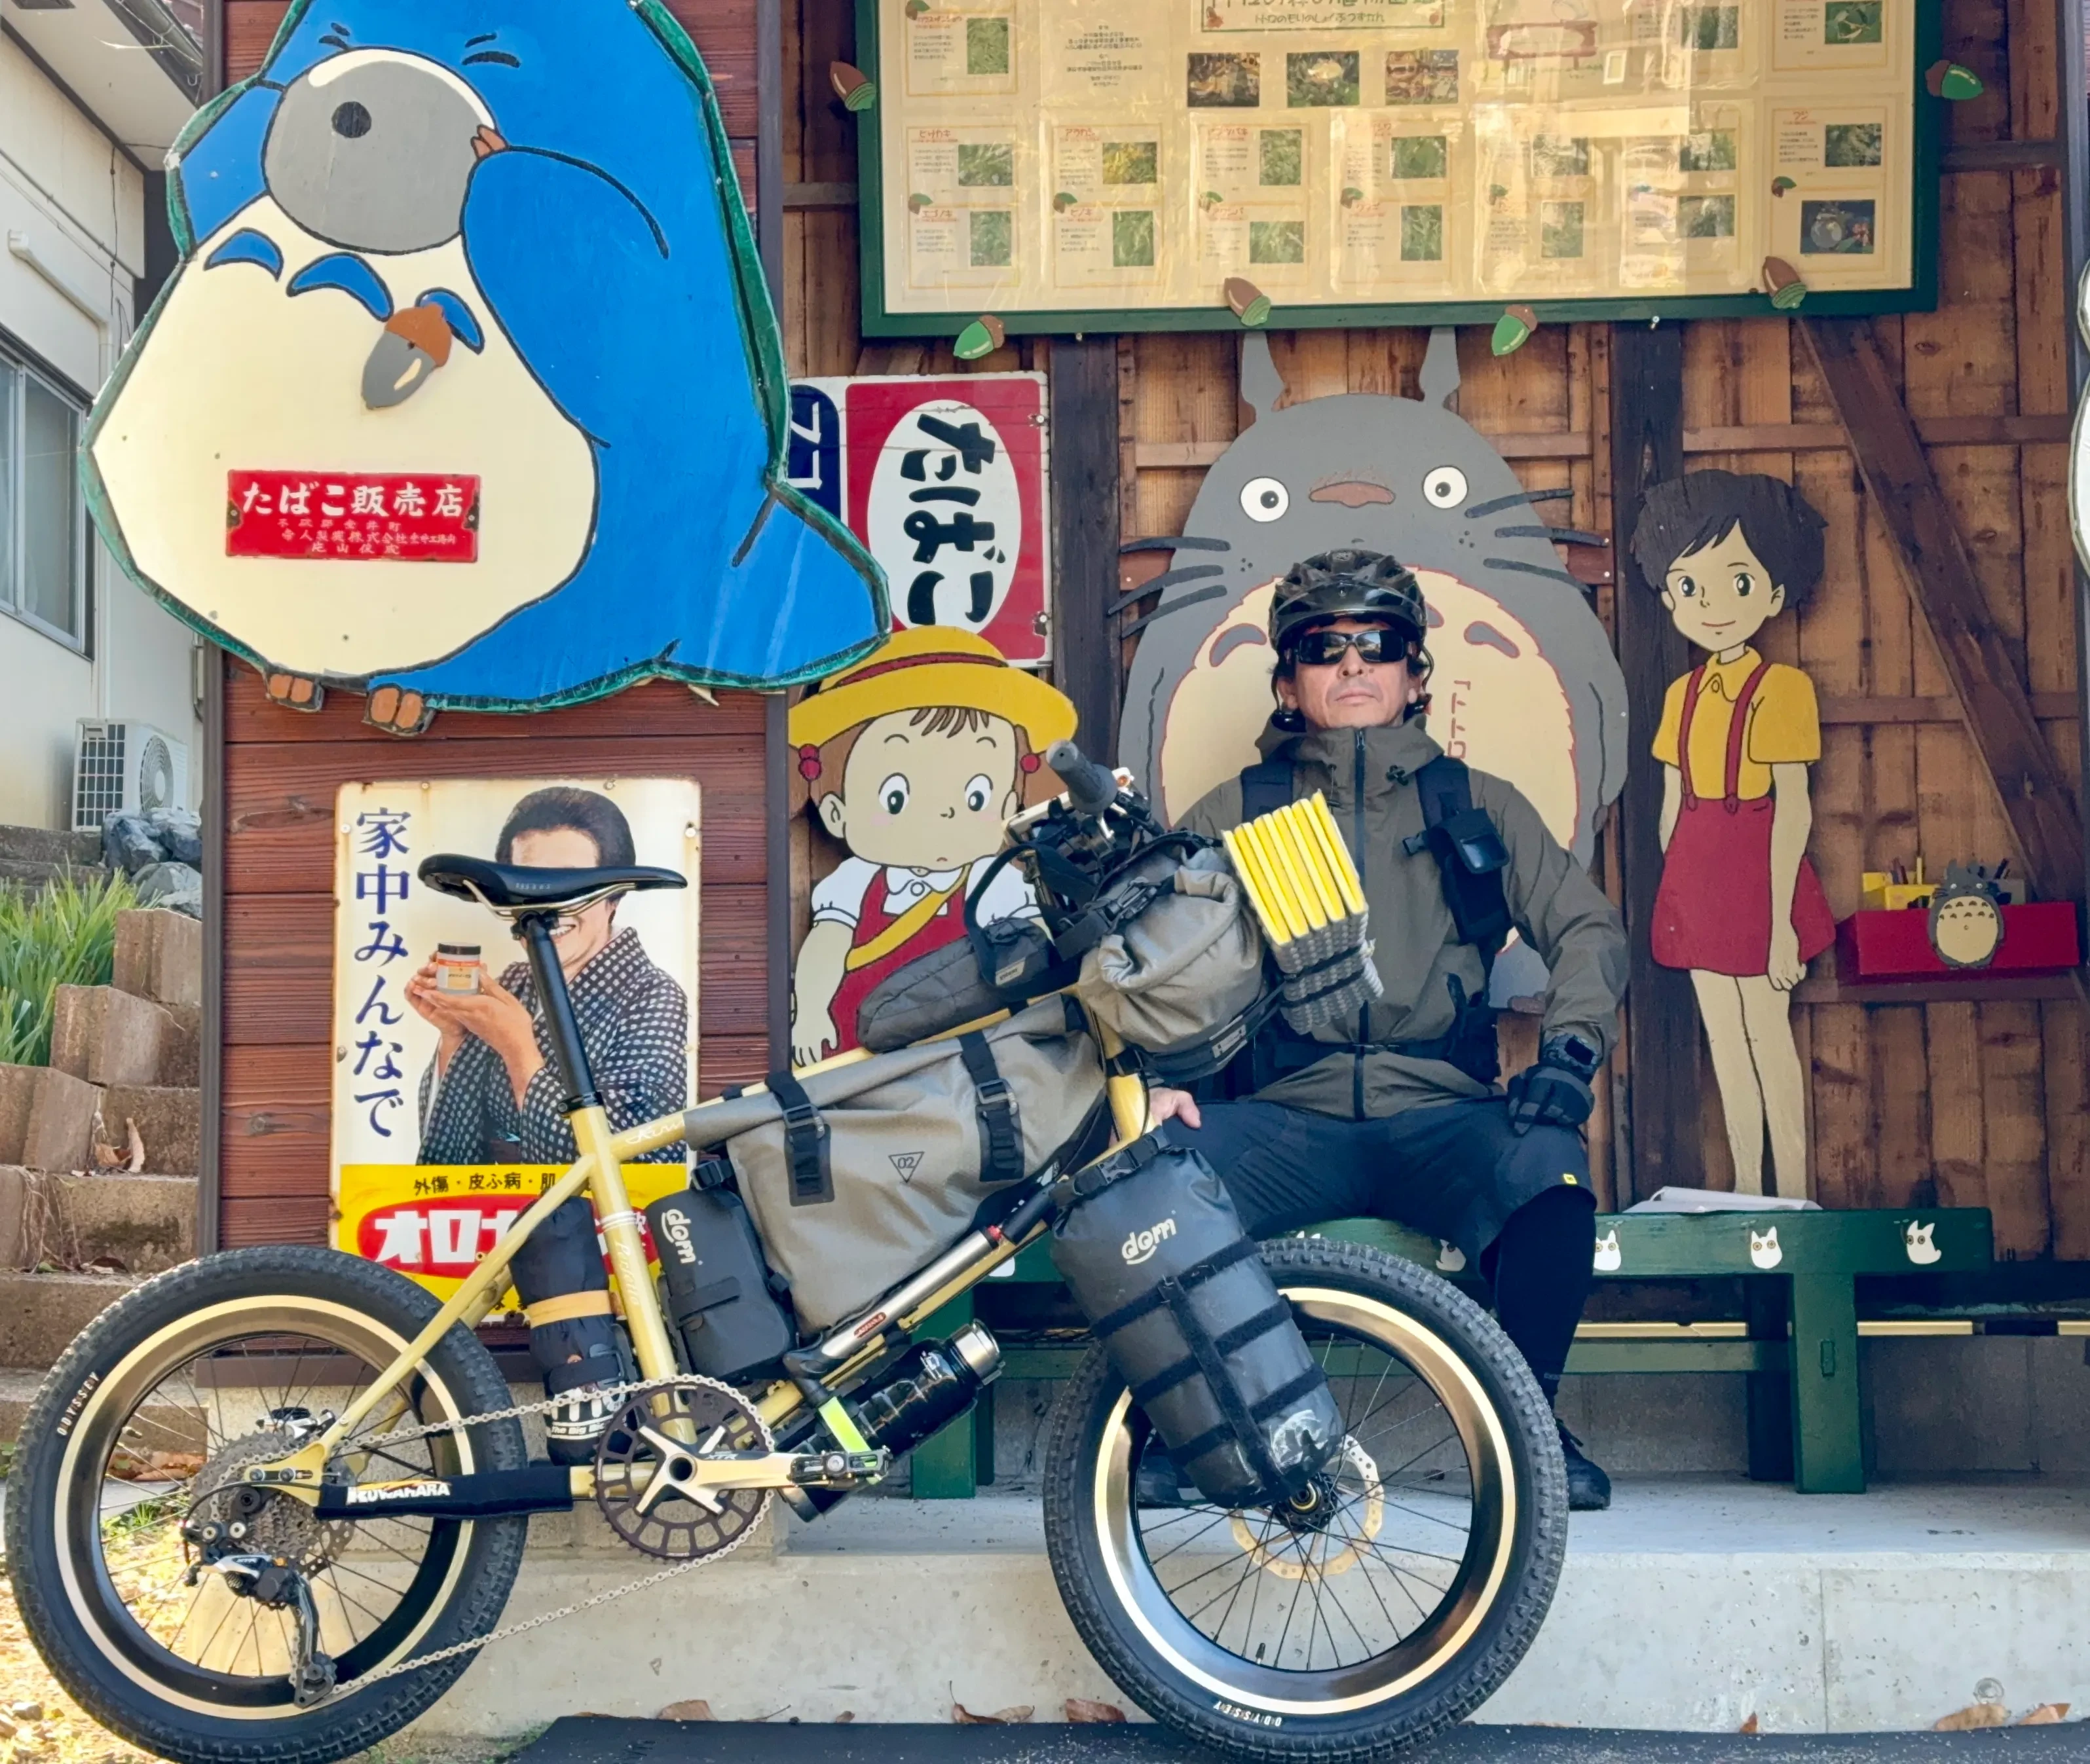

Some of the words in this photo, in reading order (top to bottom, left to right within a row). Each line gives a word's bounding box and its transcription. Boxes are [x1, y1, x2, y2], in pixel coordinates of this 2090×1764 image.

[242, 481, 464, 517] たばこ販売店
[900, 414, 1007, 625] たばこ
[352, 807, 411, 1138] 家中みんなで
[897, 1156, 916, 1169] 02
[56, 1371, 100, 1436] ODYSSEY
[346, 1482, 451, 1506] KUWAHARA
[1212, 1700, 1282, 1727] ODYSSEY
